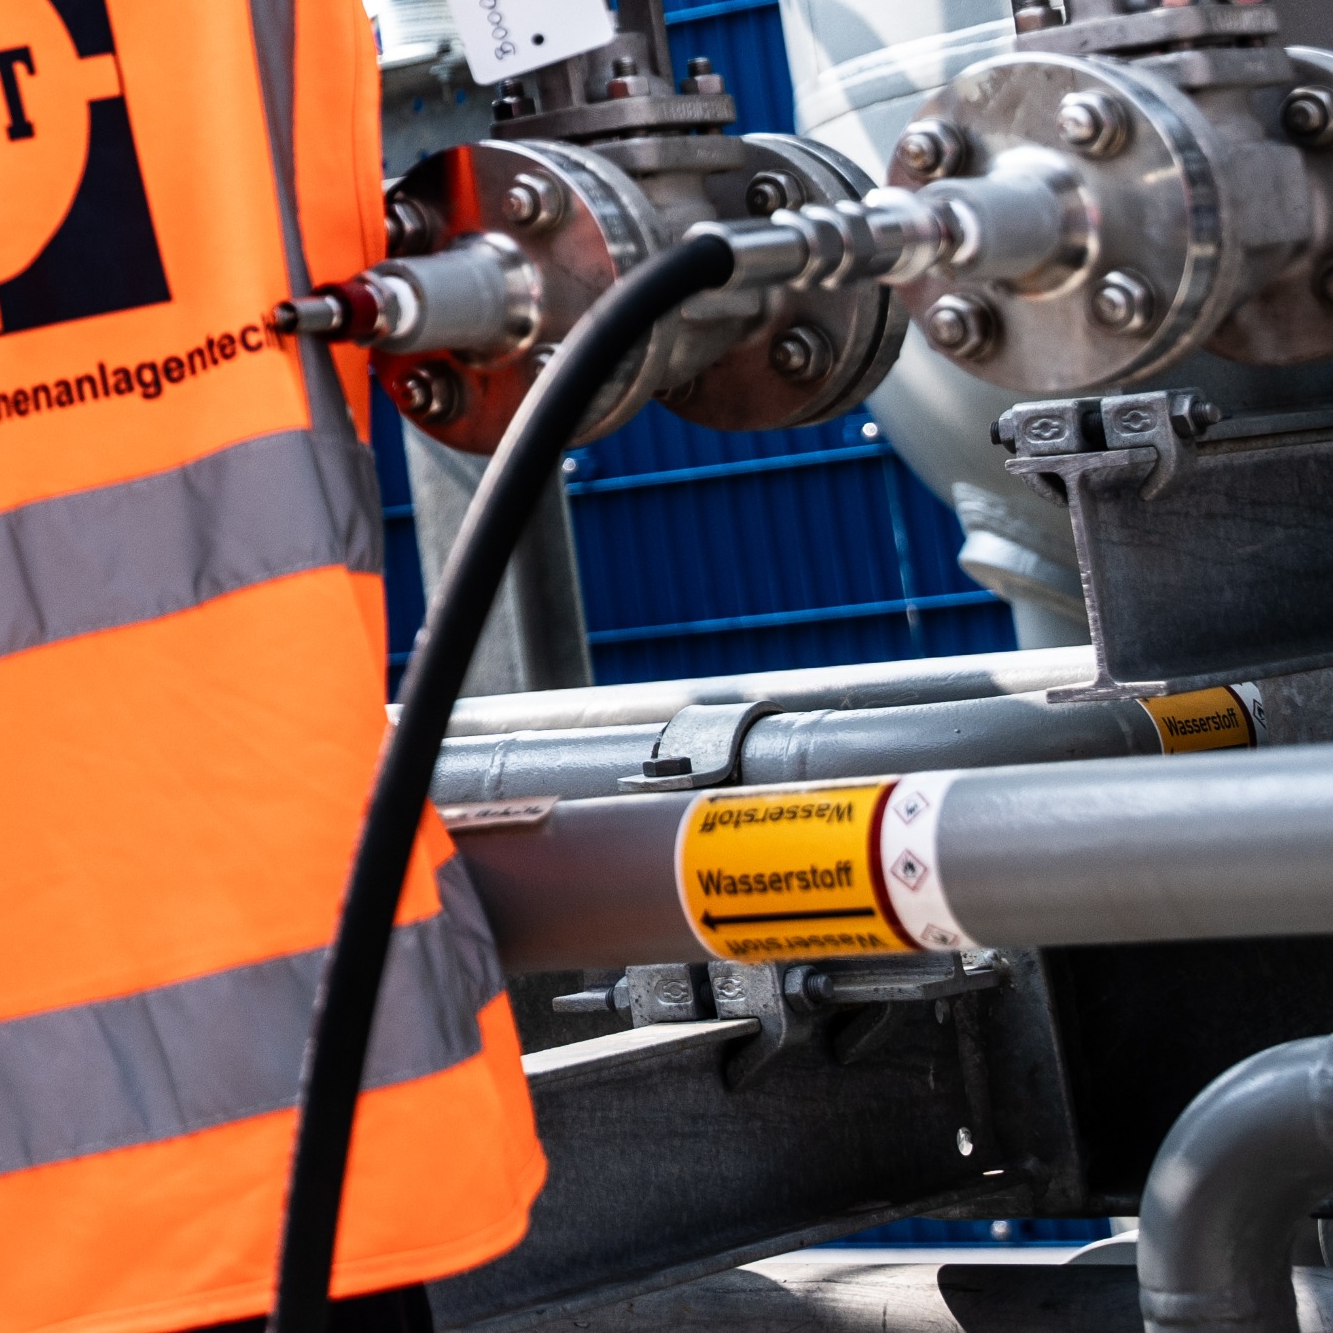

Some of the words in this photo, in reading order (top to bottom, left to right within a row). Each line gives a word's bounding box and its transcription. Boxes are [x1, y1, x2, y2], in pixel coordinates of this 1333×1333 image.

[1162, 707, 1240, 737] Wasserstoff
[700, 800, 854, 833] Wasserstoff
[696, 860, 853, 896] Wasserstoff
